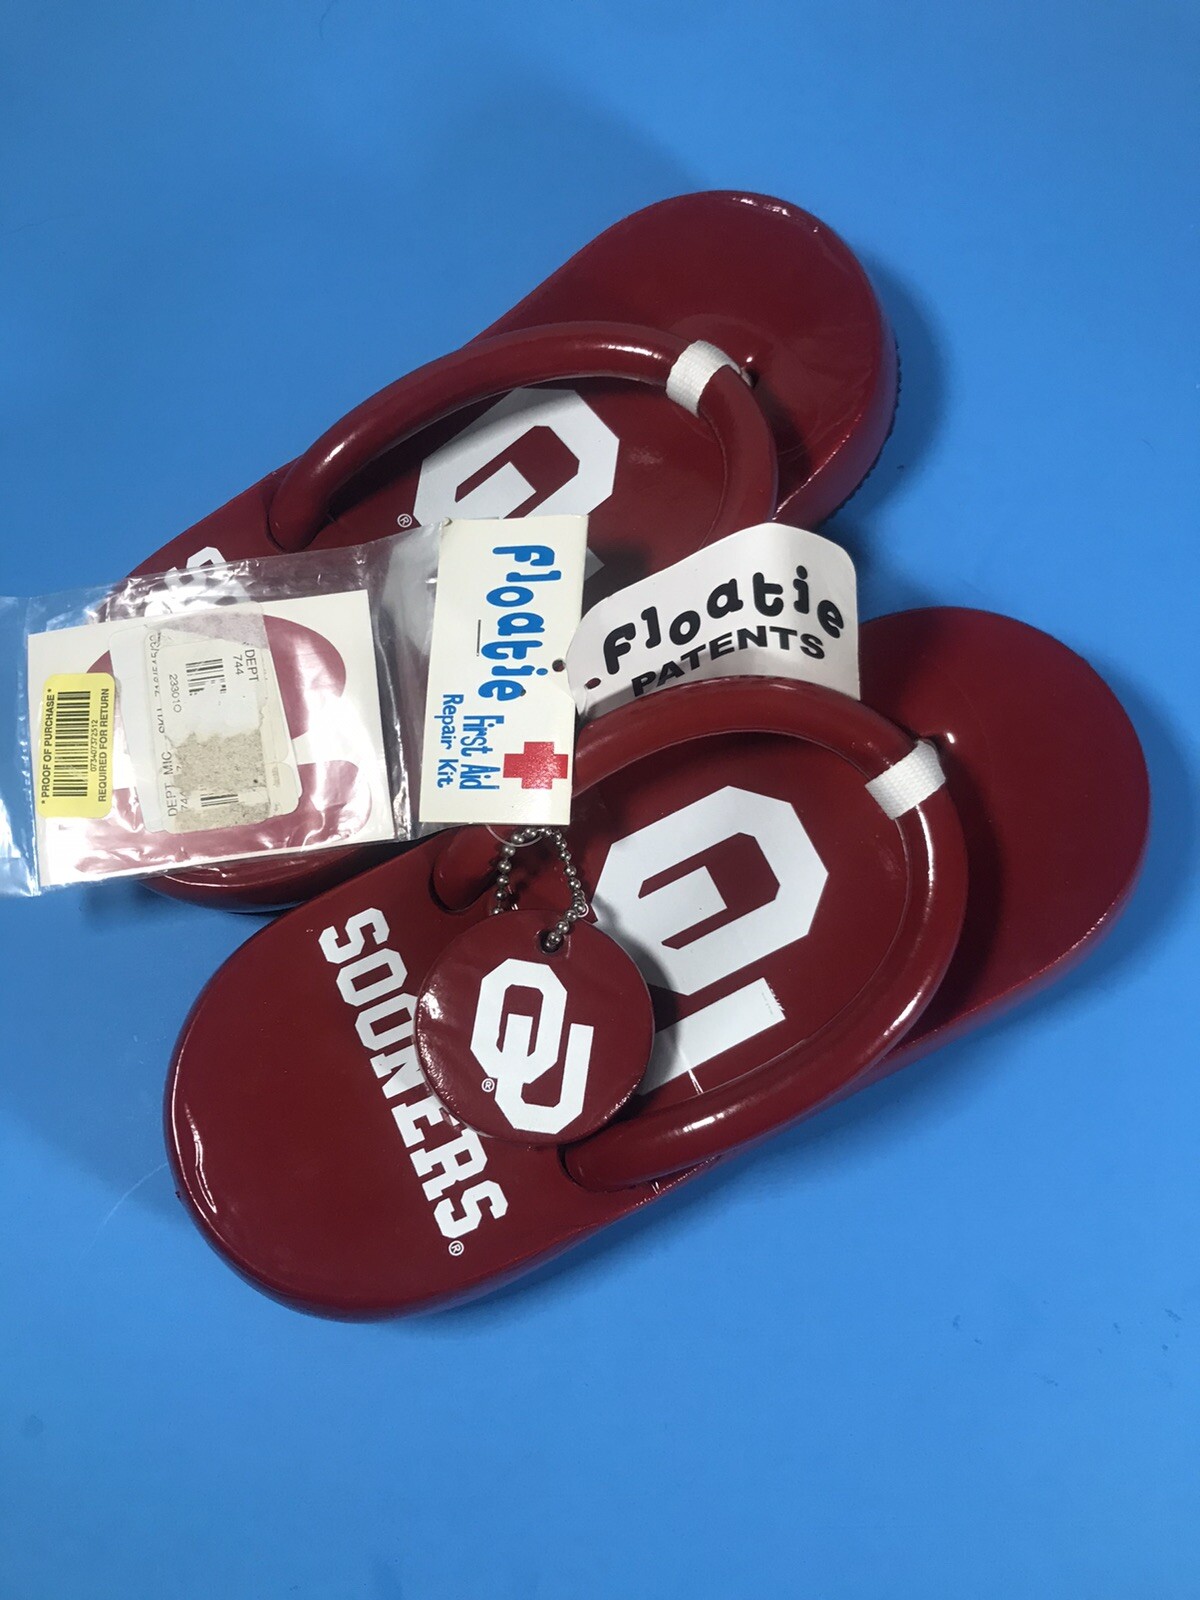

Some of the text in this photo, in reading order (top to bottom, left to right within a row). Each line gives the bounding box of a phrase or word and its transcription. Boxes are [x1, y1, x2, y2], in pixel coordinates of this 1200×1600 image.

[478, 545, 562, 701] Floatie
[603, 565, 844, 675] Floatie
[631, 625, 825, 697] PATENTS
[168, 673, 182, 713] 233010
[232, 654, 244, 676] 744
[244, 649, 259, 682] DEPT
[41, 694, 55, 798] PROOF OF PURCHASE
[98, 688, 110, 802] REQUIRED FOR RETURN
[161, 751, 177, 817] DEPT MIC
[434, 694, 464, 789] Repair Kit
[458, 715, 504, 790] First Aid
[470, 958, 595, 1135] OU
